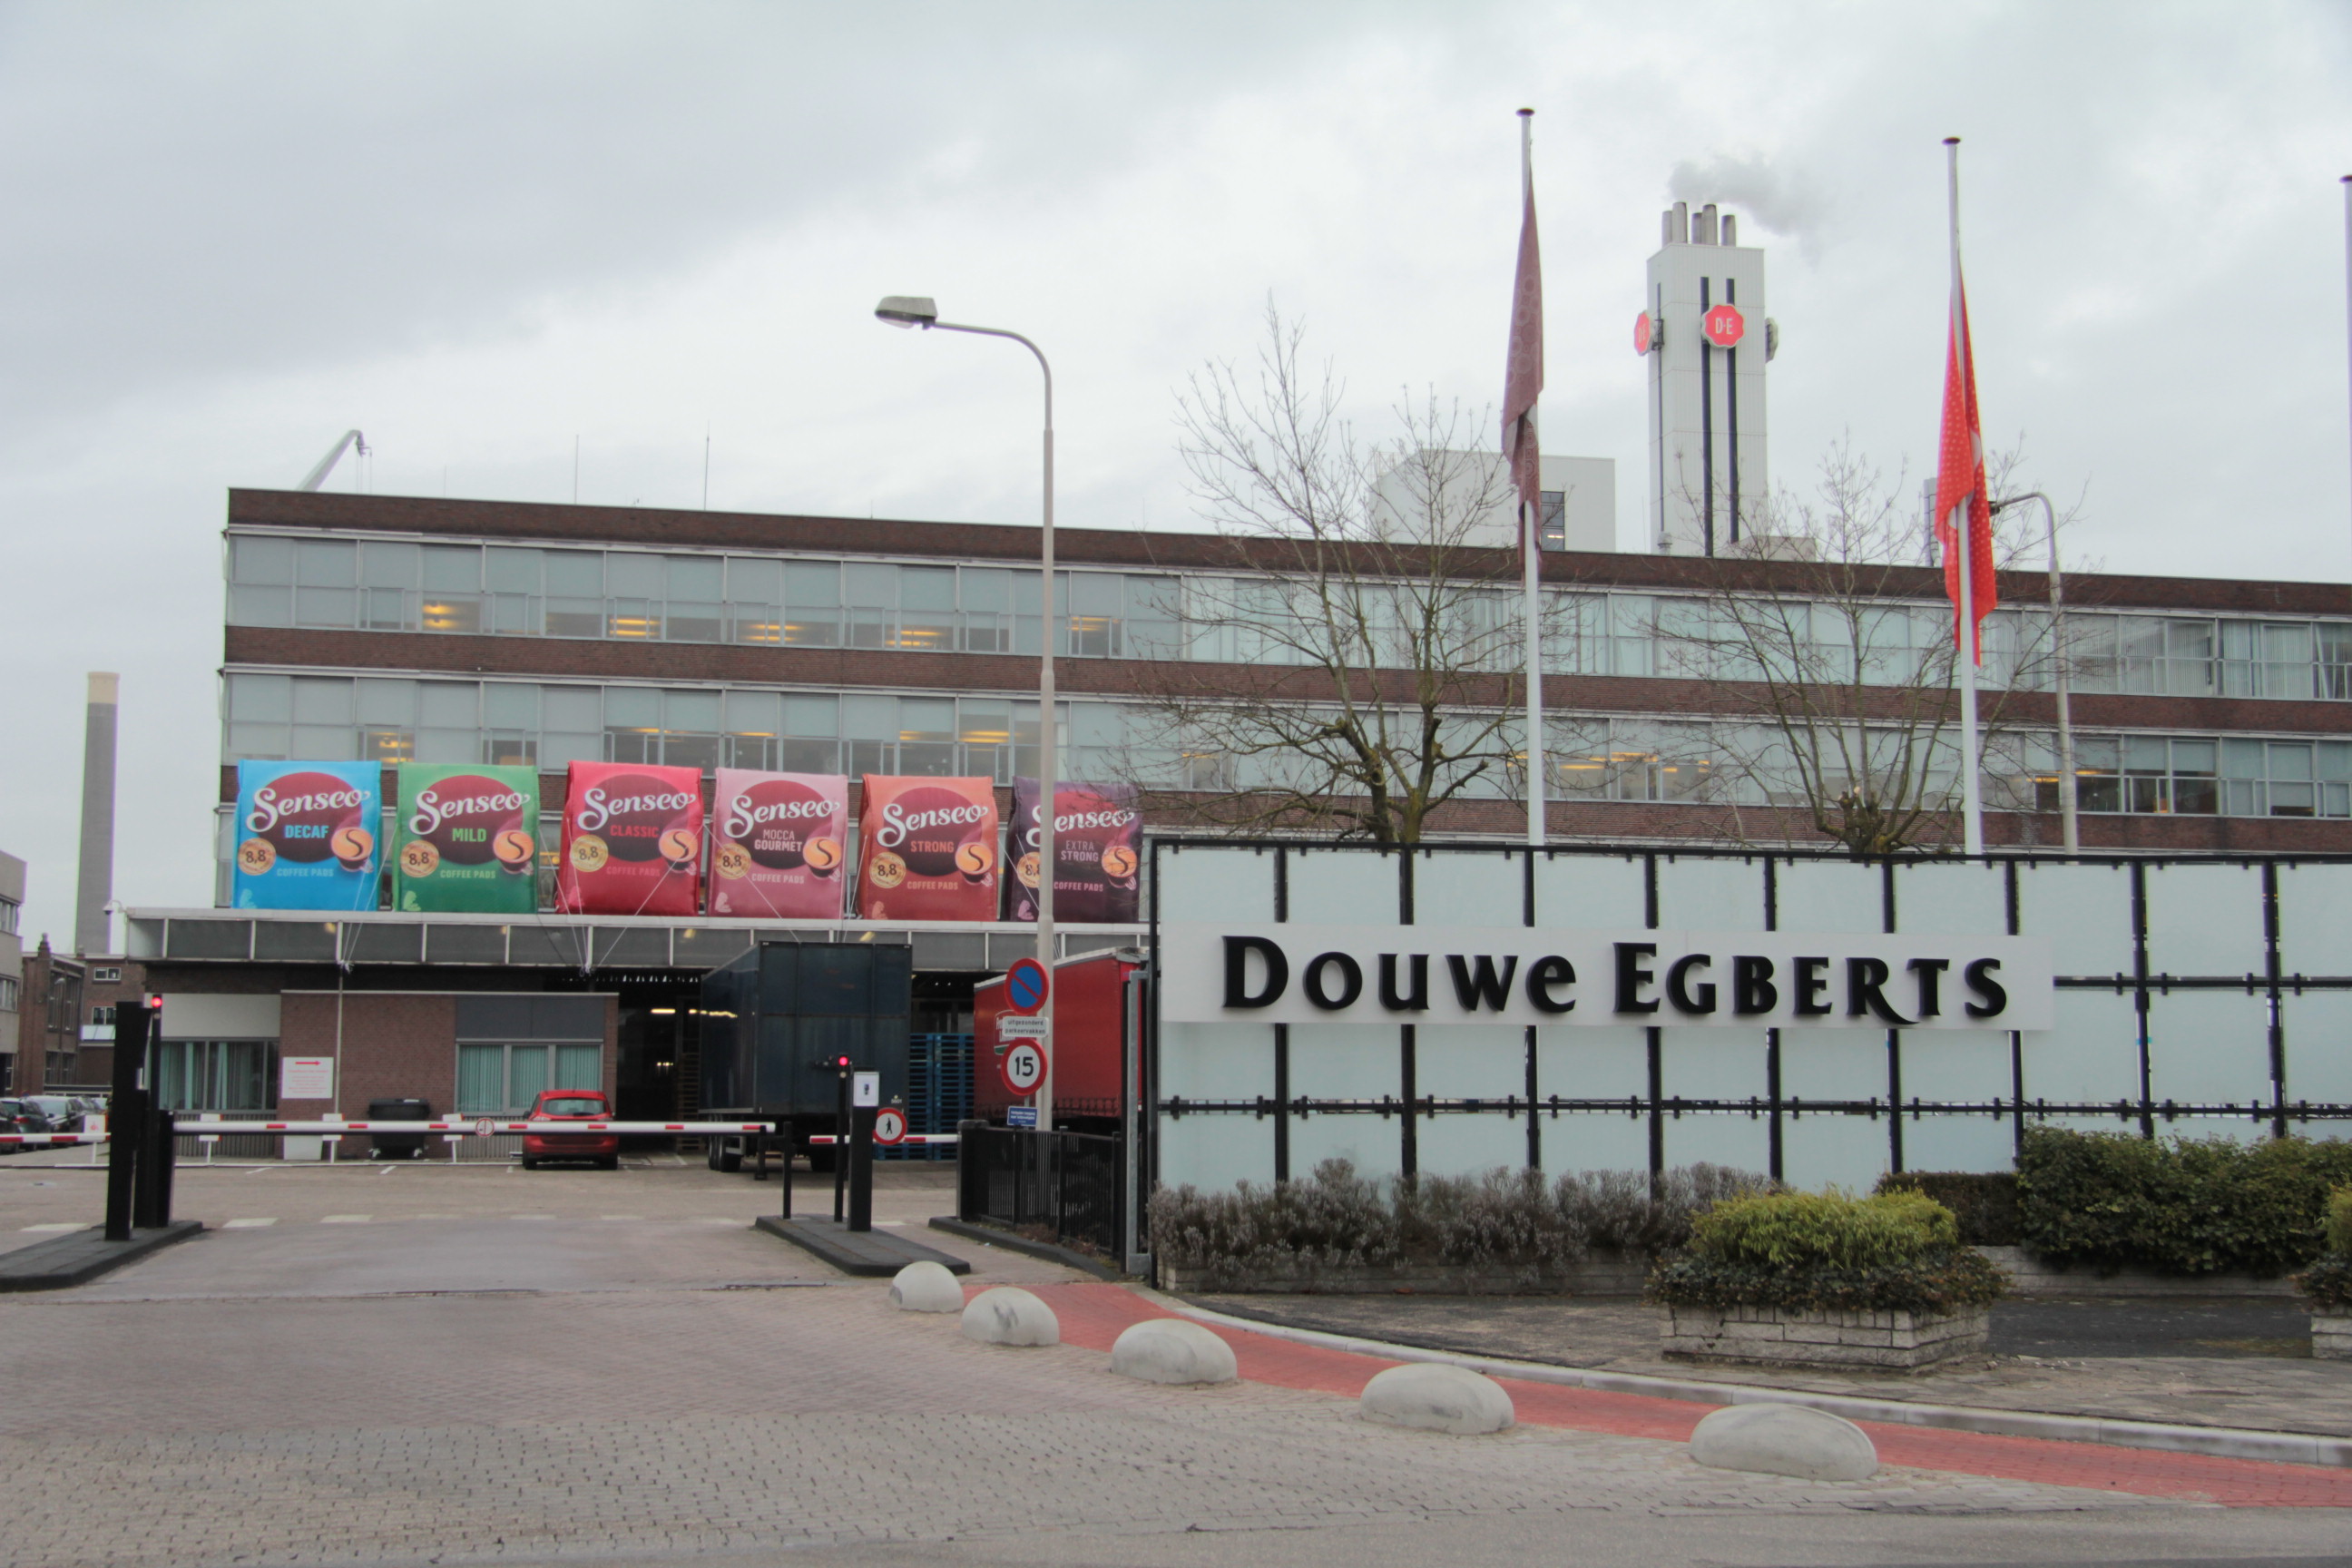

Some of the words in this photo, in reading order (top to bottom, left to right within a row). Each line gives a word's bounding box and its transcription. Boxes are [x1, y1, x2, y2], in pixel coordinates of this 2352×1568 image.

[246, 788, 370, 832] Senseo
[409, 790, 531, 835] Senseo
[577, 788, 697, 831] Senseo
[724, 795, 840, 838] Senseo
[285, 825, 329, 838] DECAF
[610, 825, 660, 838] CLASSIC
[877, 803, 988, 848] Senseo
[452, 828, 487, 842] MILD
[763, 829, 795, 841] MOCCA
[754, 839, 802, 852] GOURMET
[910, 840, 955, 853] STRONG
[1065, 840, 1094, 851] EXTRA
[246, 849, 266, 864] 8,8
[409, 852, 429, 866] 8,8
[579, 847, 599, 861] 8,8
[1061, 851, 1099, 862] STRONG
[722, 855, 742, 868] 8,8
[277, 867, 309, 877] COFFEE
[311, 868, 334, 877] PADS
[440, 869, 471, 878] COFFEE
[473, 870, 496, 879] PADS
[606, 867, 637, 876] COFFEE
[639, 867, 661, 877] PADS
[877, 864, 897, 877] 8,8
[752, 873, 780, 883] COFFEE
[783, 875, 805, 884] PADS
[907, 881, 936, 889] COFFEE
[938, 881, 958, 890] PADS
[1054, 881, 1082, 890] COFFEE
[1083, 883, 1103, 892] PADS
[1612, 942, 2007, 1024] EGBERTS
[1015, 1056, 1034, 1077] 15
